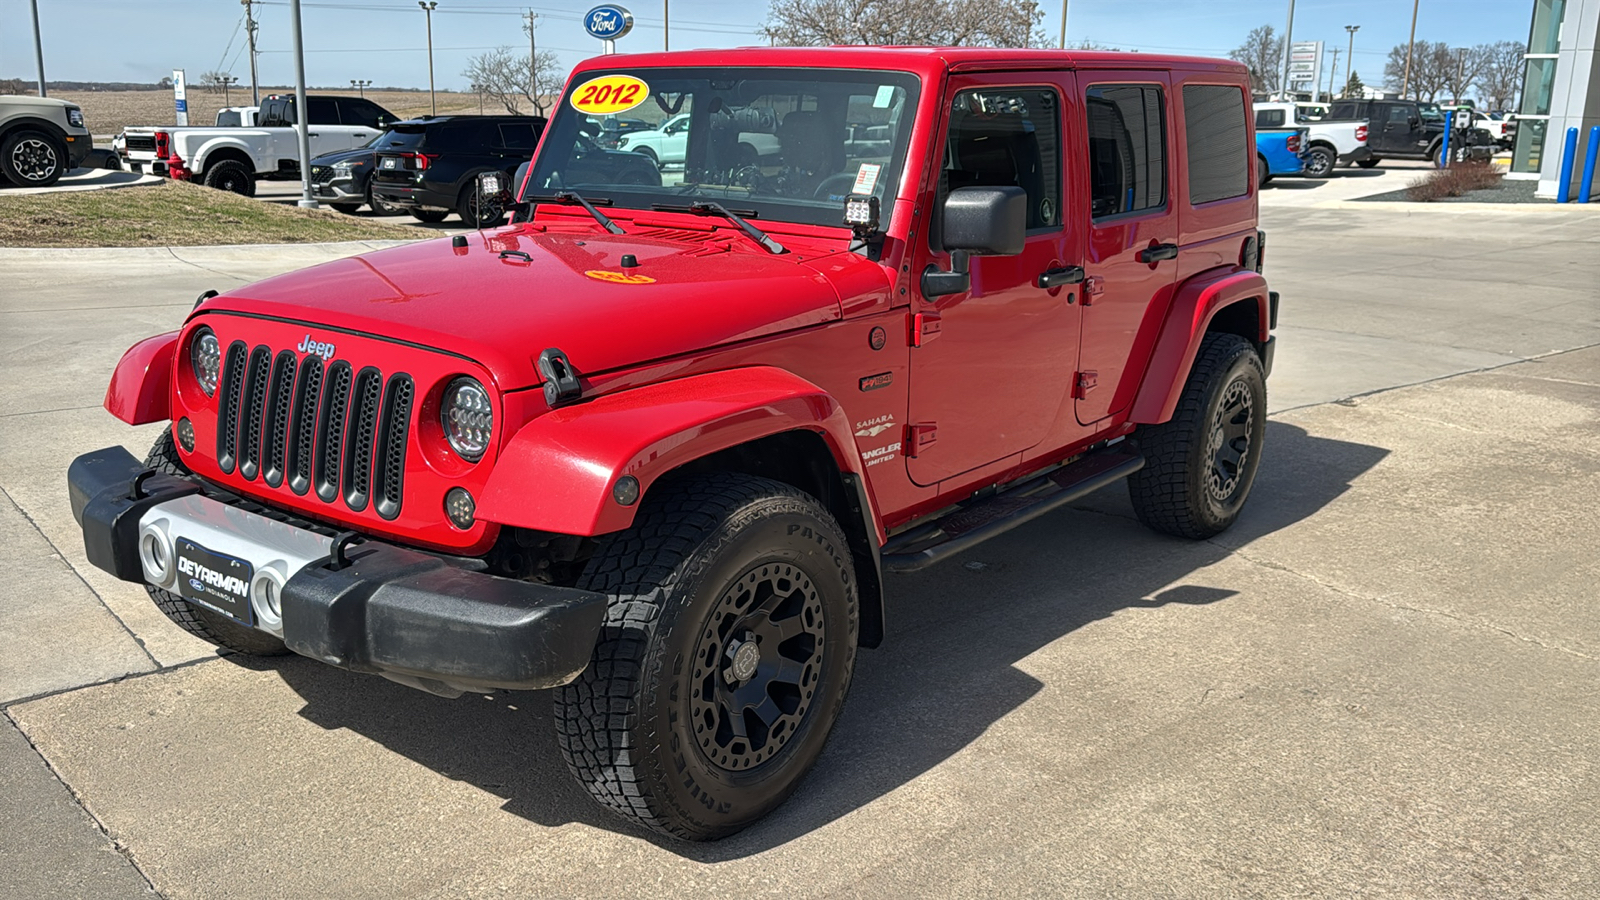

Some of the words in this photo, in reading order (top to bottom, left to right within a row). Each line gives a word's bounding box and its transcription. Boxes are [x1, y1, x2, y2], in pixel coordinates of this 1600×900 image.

[591, 12, 616, 31] Ford
[578, 84, 640, 105] 2012
[298, 334, 335, 360] Jeep
[857, 413, 893, 429] SAHARA
[861, 442, 902, 460] ANGLER
[178, 556, 249, 597] DEYARMAN
[205, 586, 236, 604] INDIANOLA
[667, 651, 715, 810] MILESTAR
